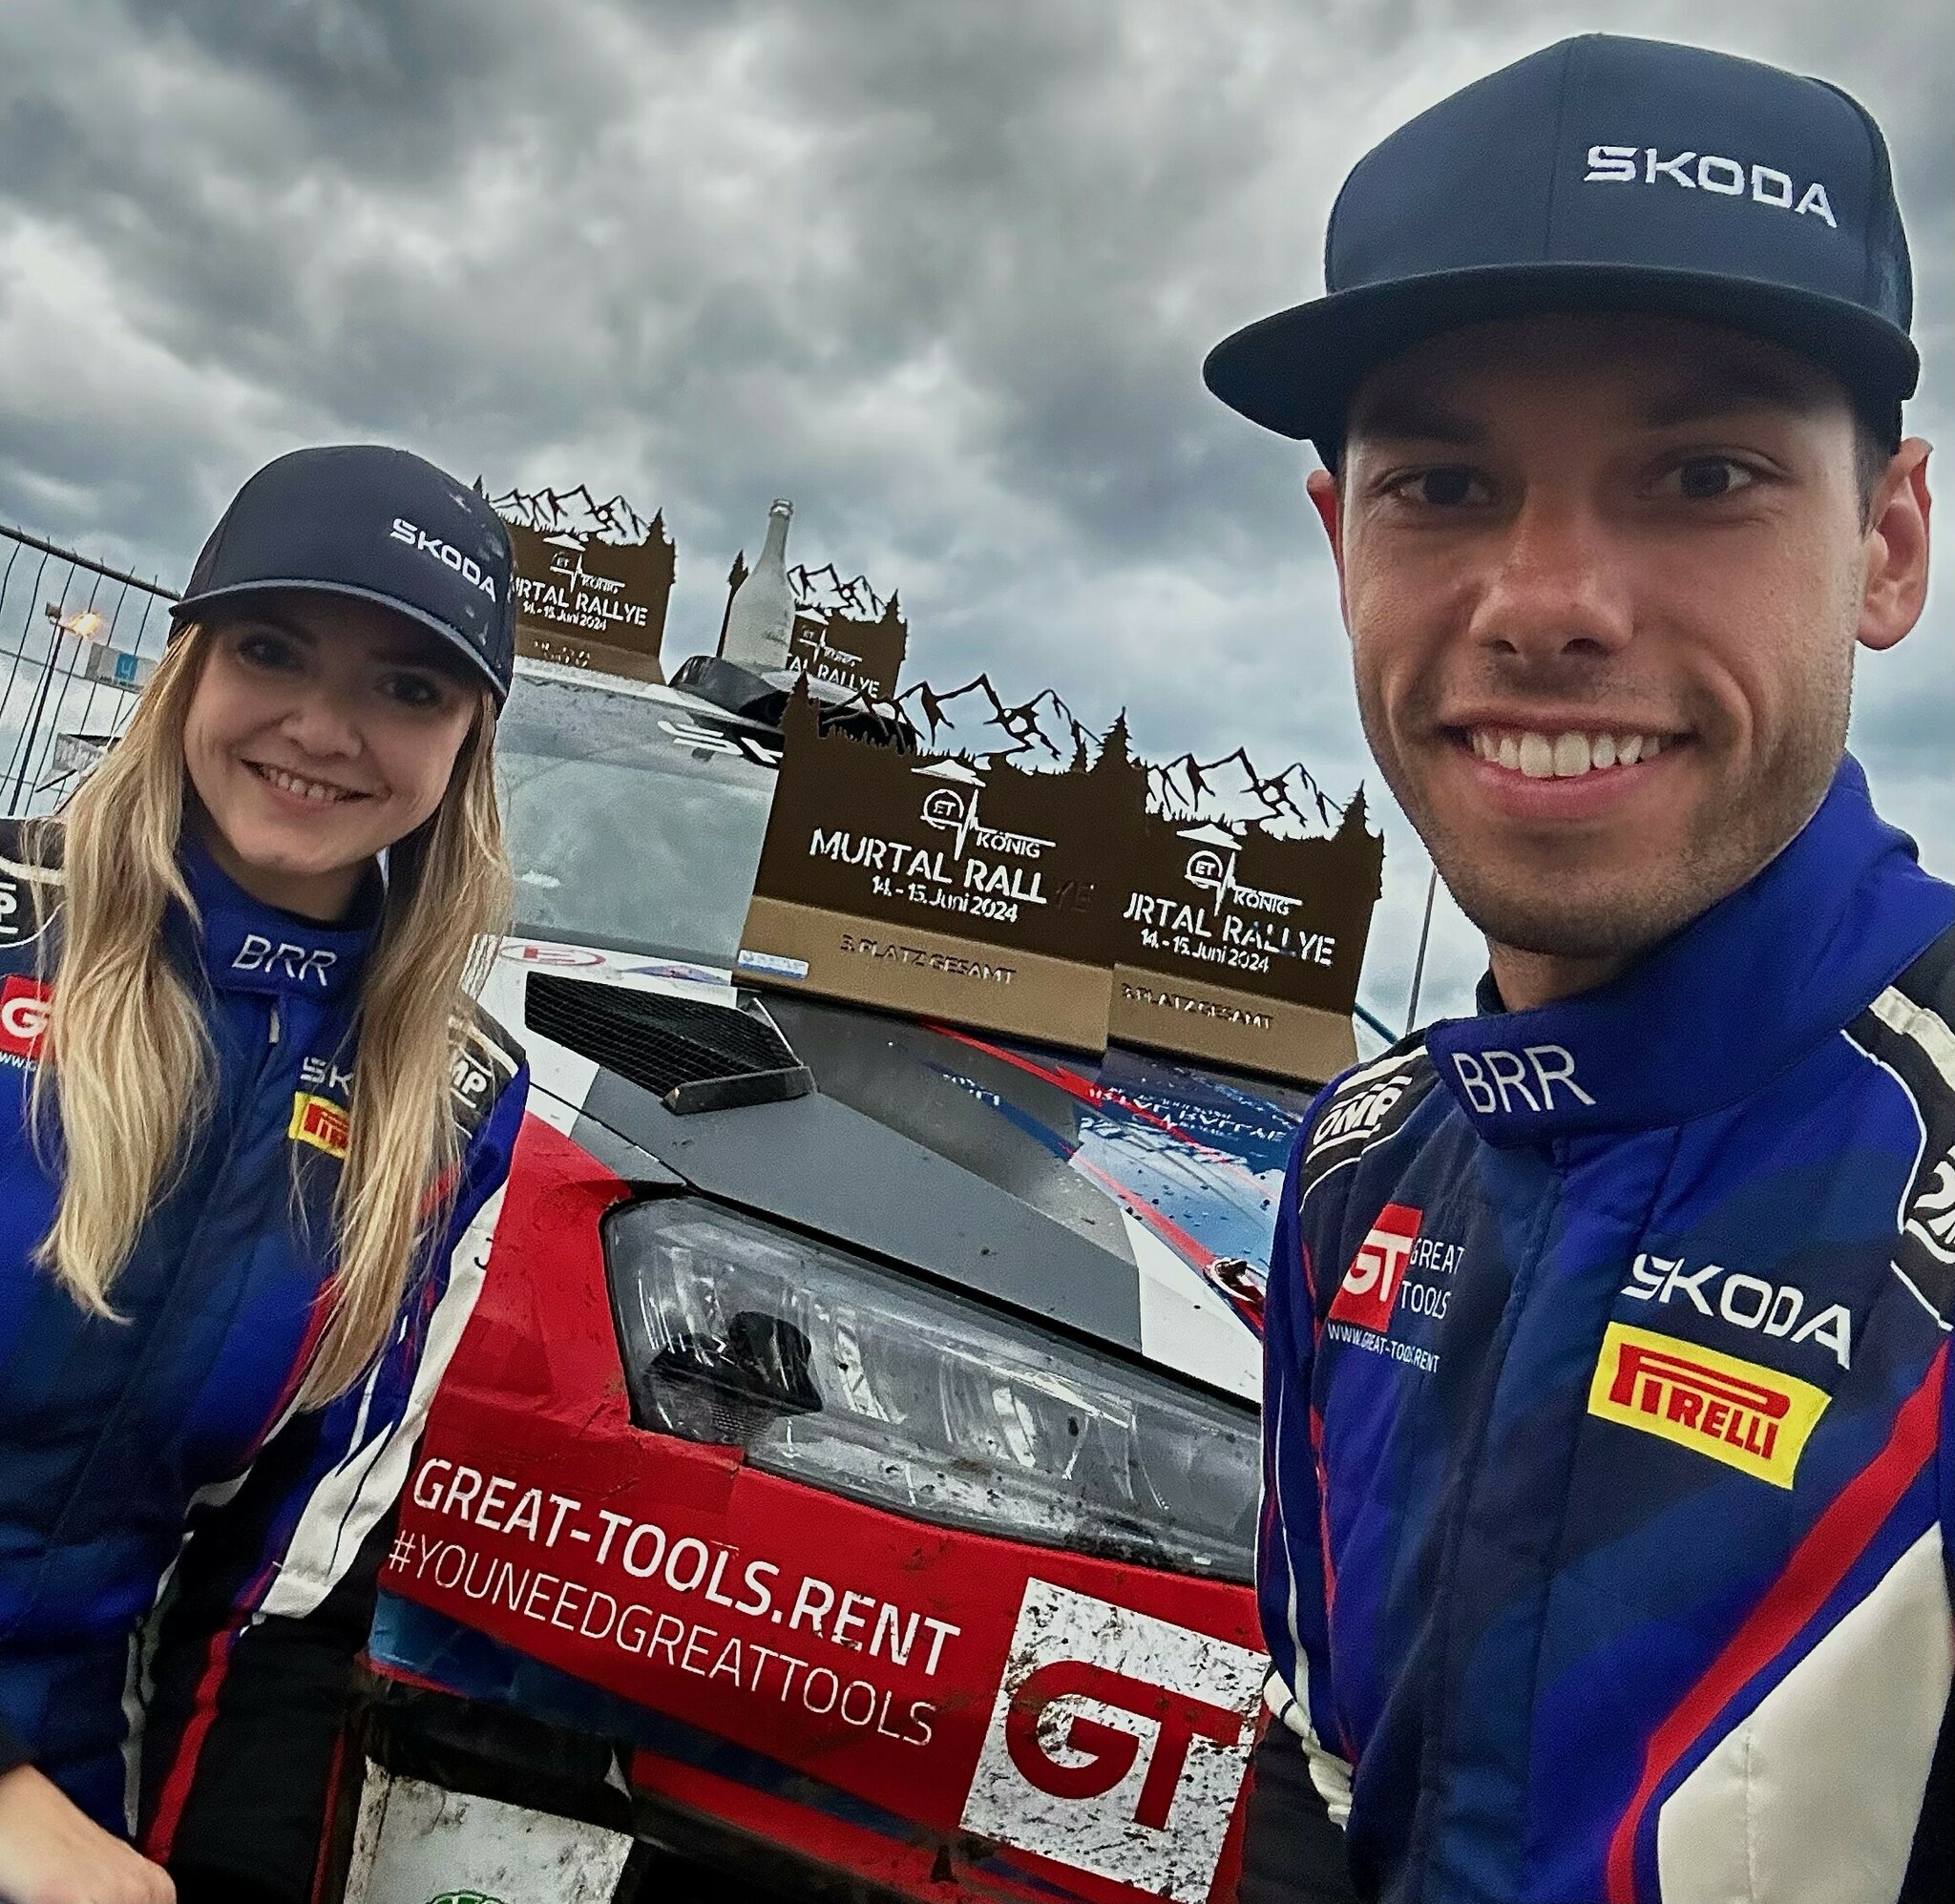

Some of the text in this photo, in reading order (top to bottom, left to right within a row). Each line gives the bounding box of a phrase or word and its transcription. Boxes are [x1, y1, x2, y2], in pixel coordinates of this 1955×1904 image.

[515, 575, 649, 627] RTAL RALLYE
[817, 663, 880, 700] RALLYE
[932, 799, 956, 817] ET
[809, 826, 953, 885] MURTAL
[976, 830, 1041, 859] KÖNIG
[929, 888, 970, 913] Juni
[969, 895, 1020, 924] 2024
[231, 933, 338, 987] BRR
[1191, 940, 1228, 964] Juni
[1227, 947, 1270, 973] 2024
[1222, 913, 1336, 969] RALLYE
[1, 996, 53, 1038] G
[450, 1059, 487, 1095] MP
[1450, 1044, 1597, 1114] BRR
[1313, 1086, 1403, 1146] OMP
[1341, 1228, 1415, 1304] GT
[1409, 1236, 1466, 1276] GREAT
[1400, 1280, 1452, 1321] TOOLS
[1608, 1342, 1791, 1460] PIRELLI
[412, 1457, 961, 1676] GREAT-TOOLS.RENT
[389, 1529, 936, 1747] #YOUNEEDGREATTOOLS
[1004, 1660, 1245, 1831] GT
